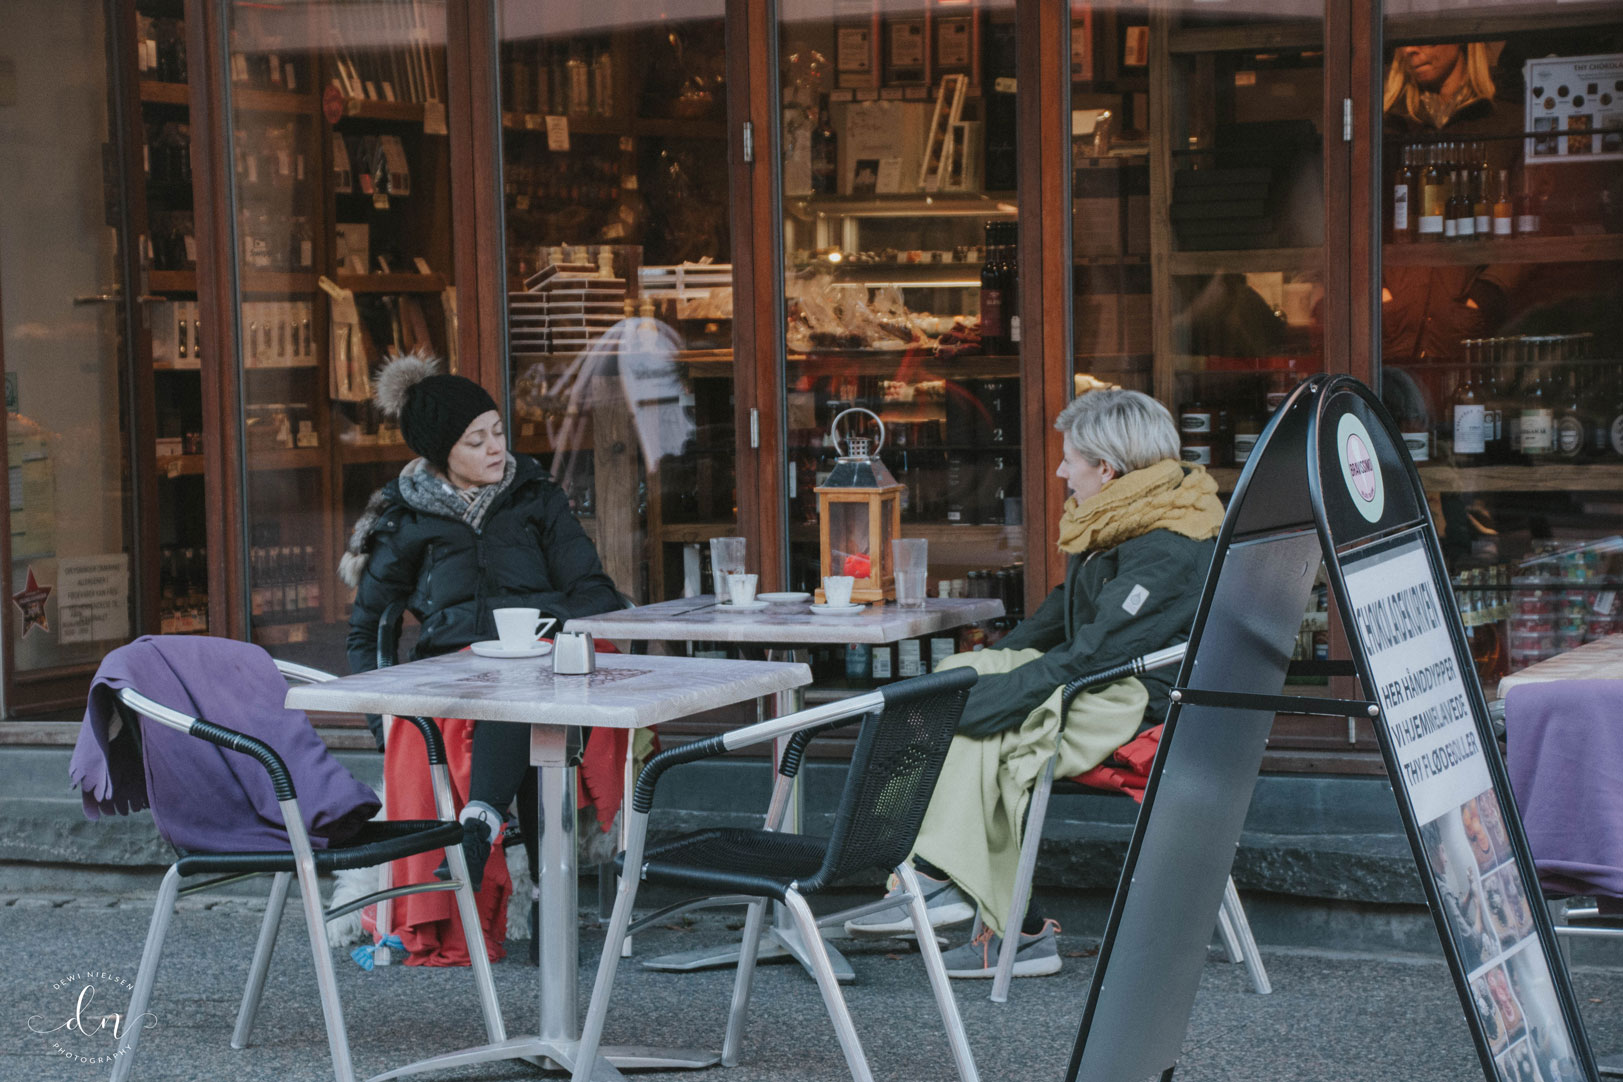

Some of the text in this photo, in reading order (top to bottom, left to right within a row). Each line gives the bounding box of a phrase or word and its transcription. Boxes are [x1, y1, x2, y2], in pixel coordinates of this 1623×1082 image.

[993, 428, 1003, 441] 2
[994, 457, 1004, 470] 3
[1381, 657, 1457, 710] HER HÅNDDYPPER
[1391, 723, 1406, 749] VI
[1404, 731, 1480, 787] THY FLØDEBOLLER
